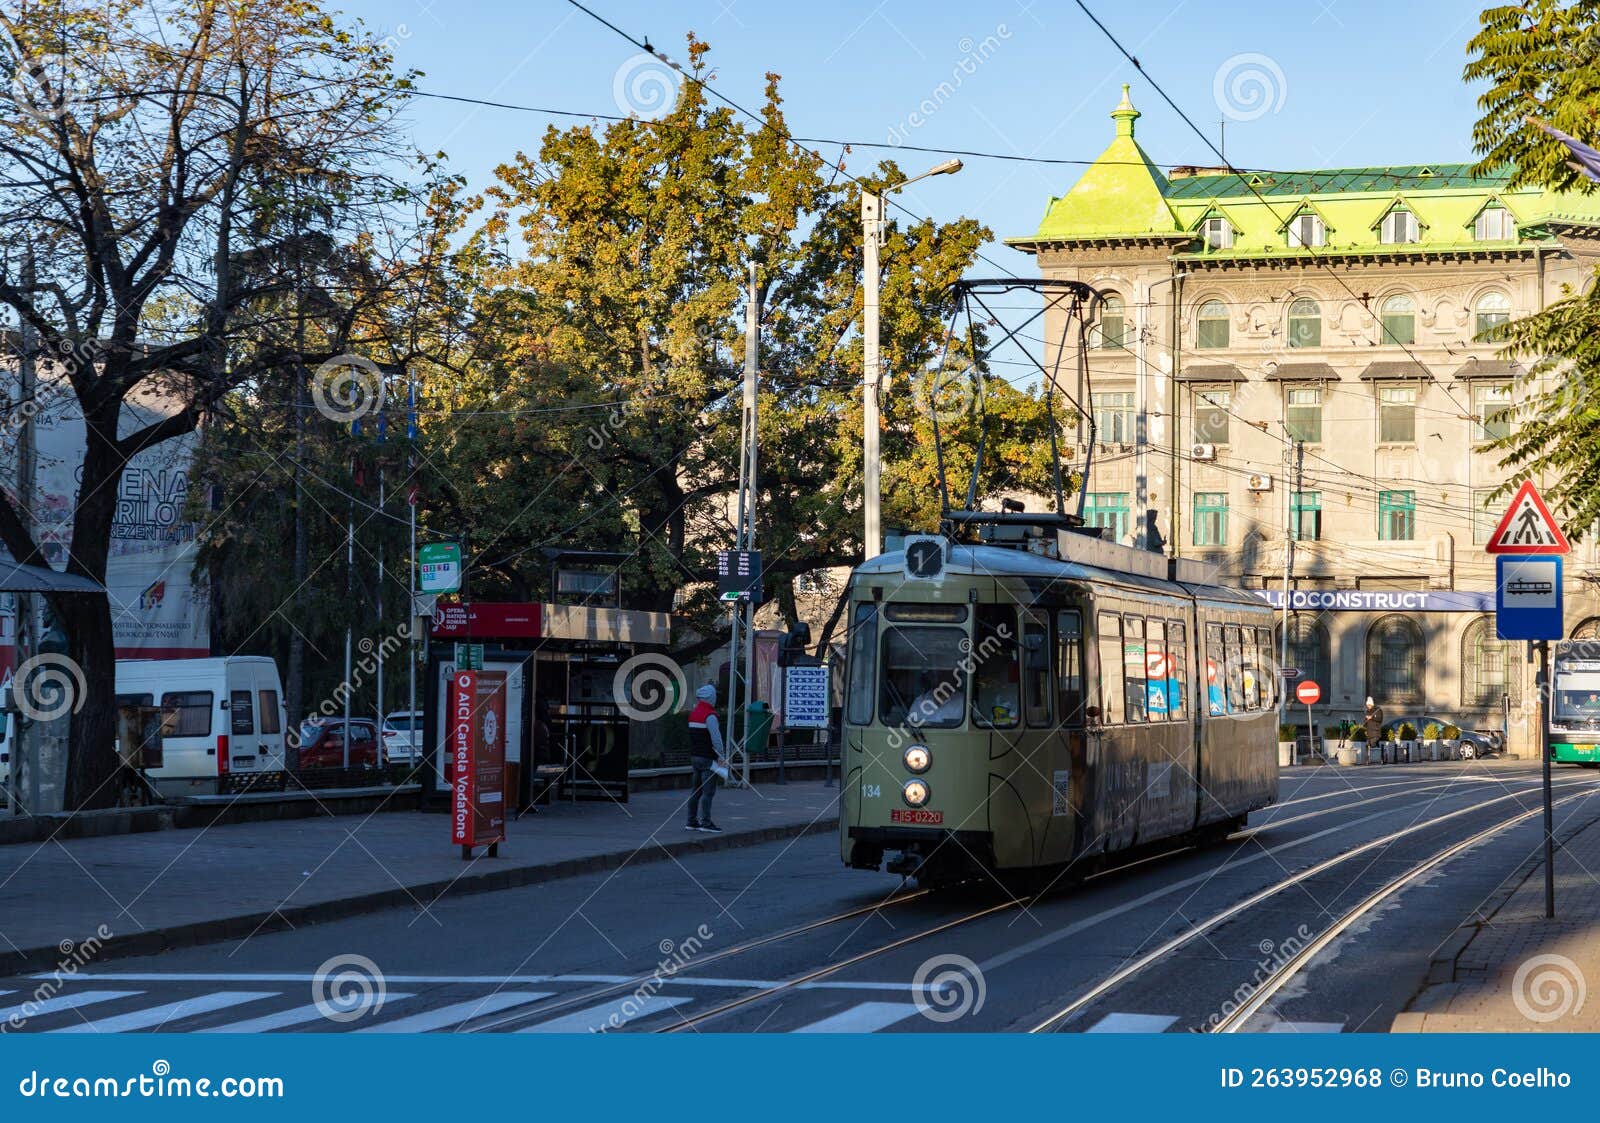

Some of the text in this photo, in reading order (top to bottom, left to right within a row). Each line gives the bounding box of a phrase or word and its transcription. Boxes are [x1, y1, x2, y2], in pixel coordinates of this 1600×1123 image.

[118, 467, 189, 504] ENA
[912, 548, 924, 573] 1
[455, 692, 471, 840] AICI Cartela Vodafone
[861, 784, 881, 799] 134
